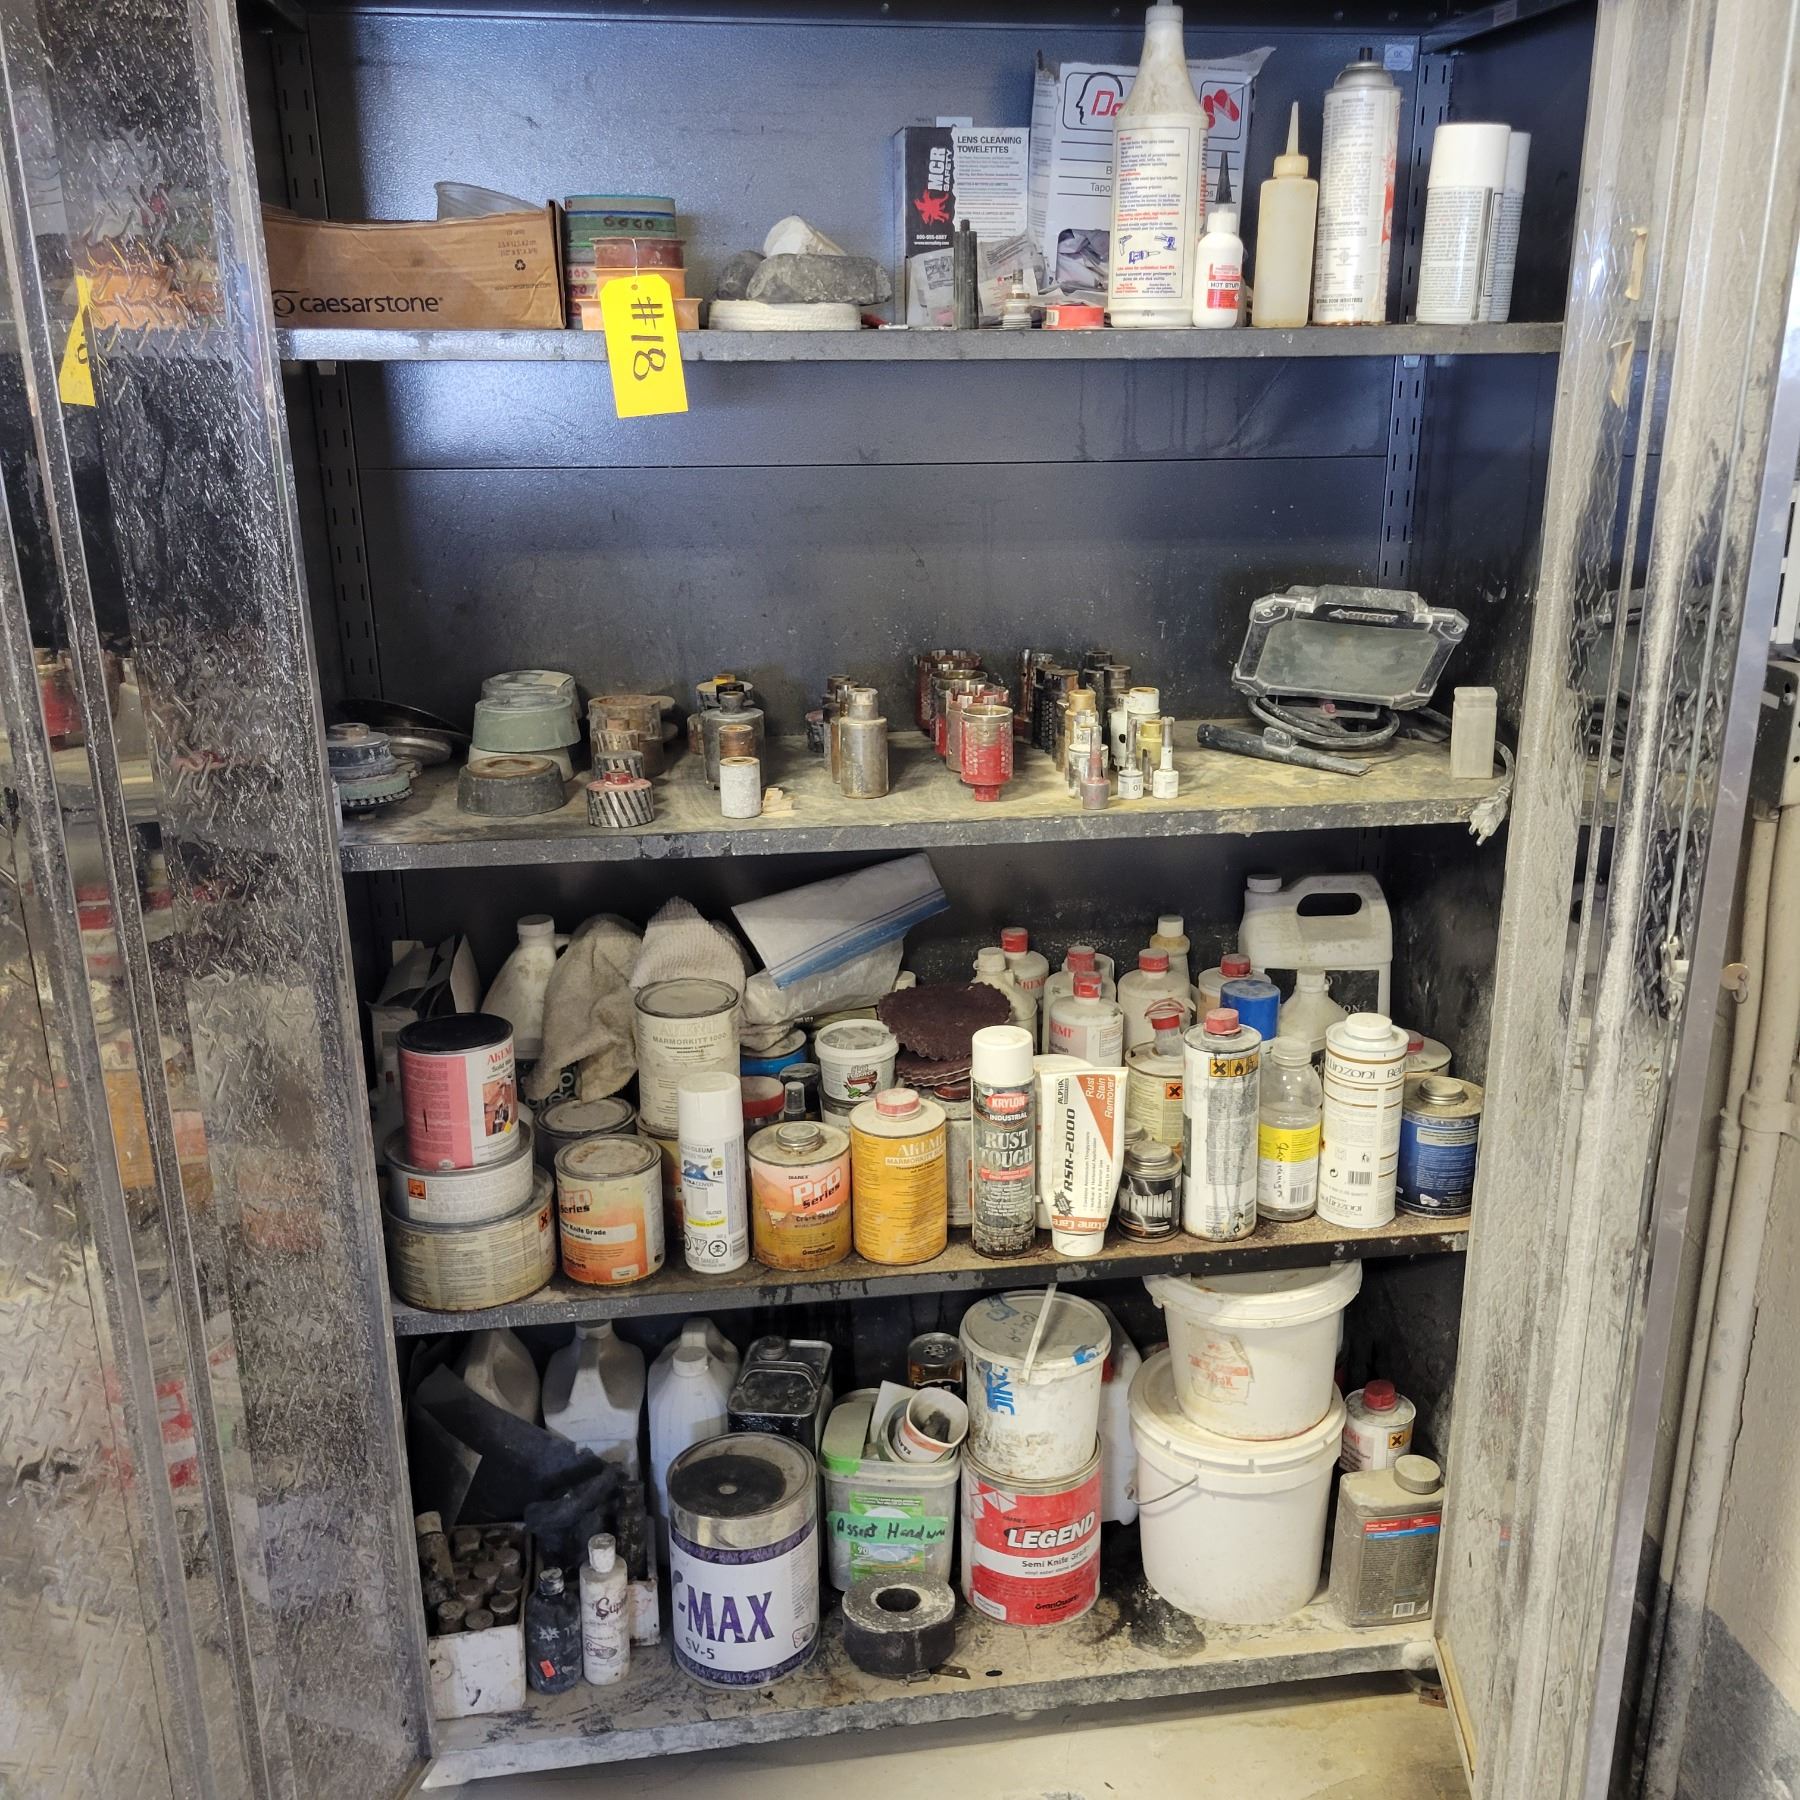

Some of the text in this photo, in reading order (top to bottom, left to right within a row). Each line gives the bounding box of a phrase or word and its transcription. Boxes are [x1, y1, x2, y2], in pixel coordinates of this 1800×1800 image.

[957, 135, 1022, 144] LENS CLEANING
[957, 145, 1009, 154] TOWELETTES
[927, 146, 946, 191] MCR
[943, 150, 954, 192] SAFETY
[300, 295, 439, 313] caesarstone
[630, 296, 667, 381] #18
[652, 1034, 708, 1046] MARMORKITT
[1086, 1077, 1095, 1098] Rust
[1096, 1077, 1105, 1100] Stain
[1105, 1077, 1115, 1119] Remover
[991, 1095, 1025, 1109] KRYLON
[989, 1111, 1028, 1122] INDUSTRIAL
[984, 1129, 1029, 1150] RUST
[1064, 1108, 1076, 1192] RSR-2000
[979, 1144, 1033, 1168] TOUGH
[791, 1166, 842, 1206] Pro
[802, 1182, 840, 1210] Series
[1007, 1511, 1096, 1549] LEGEND
[1021, 1560, 1045, 1568] Semi
[1047, 1556, 1069, 1567] Knife
[673, 1570, 775, 1643] -MAX
[685, 1636, 716, 1661] SV-5
